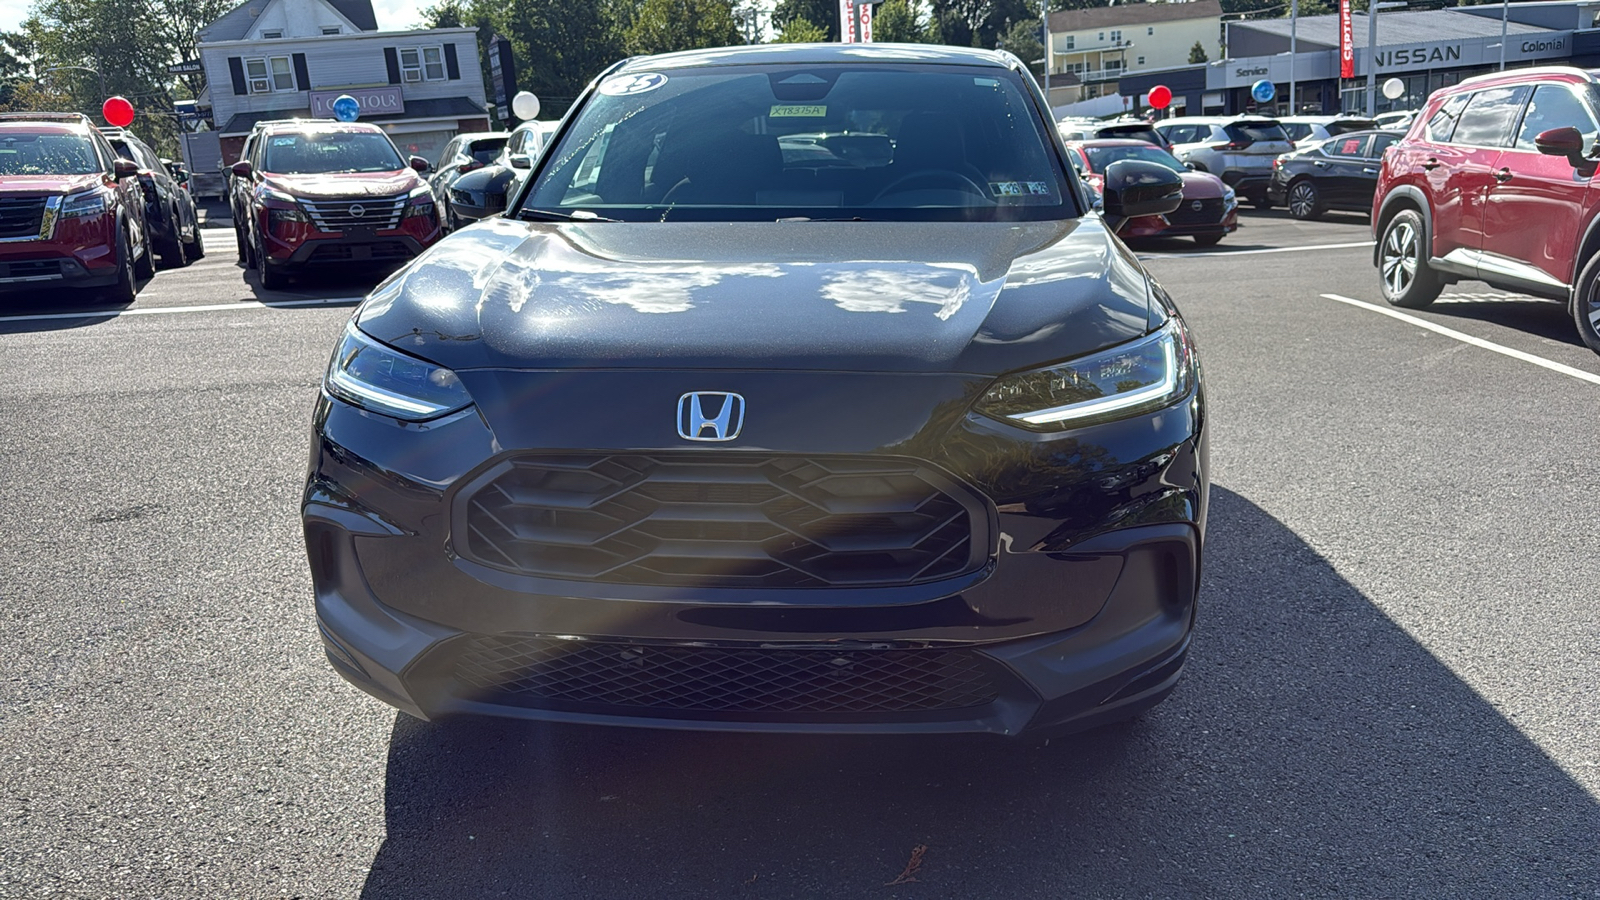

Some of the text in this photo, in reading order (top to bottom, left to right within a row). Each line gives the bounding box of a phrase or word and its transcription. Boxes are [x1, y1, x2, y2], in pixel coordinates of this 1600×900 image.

[1375, 45, 1461, 67] NISSAN
[1521, 38, 1565, 53] Colonial
[1236, 66, 1268, 77] Service
[326, 94, 397, 111] CTOUR
